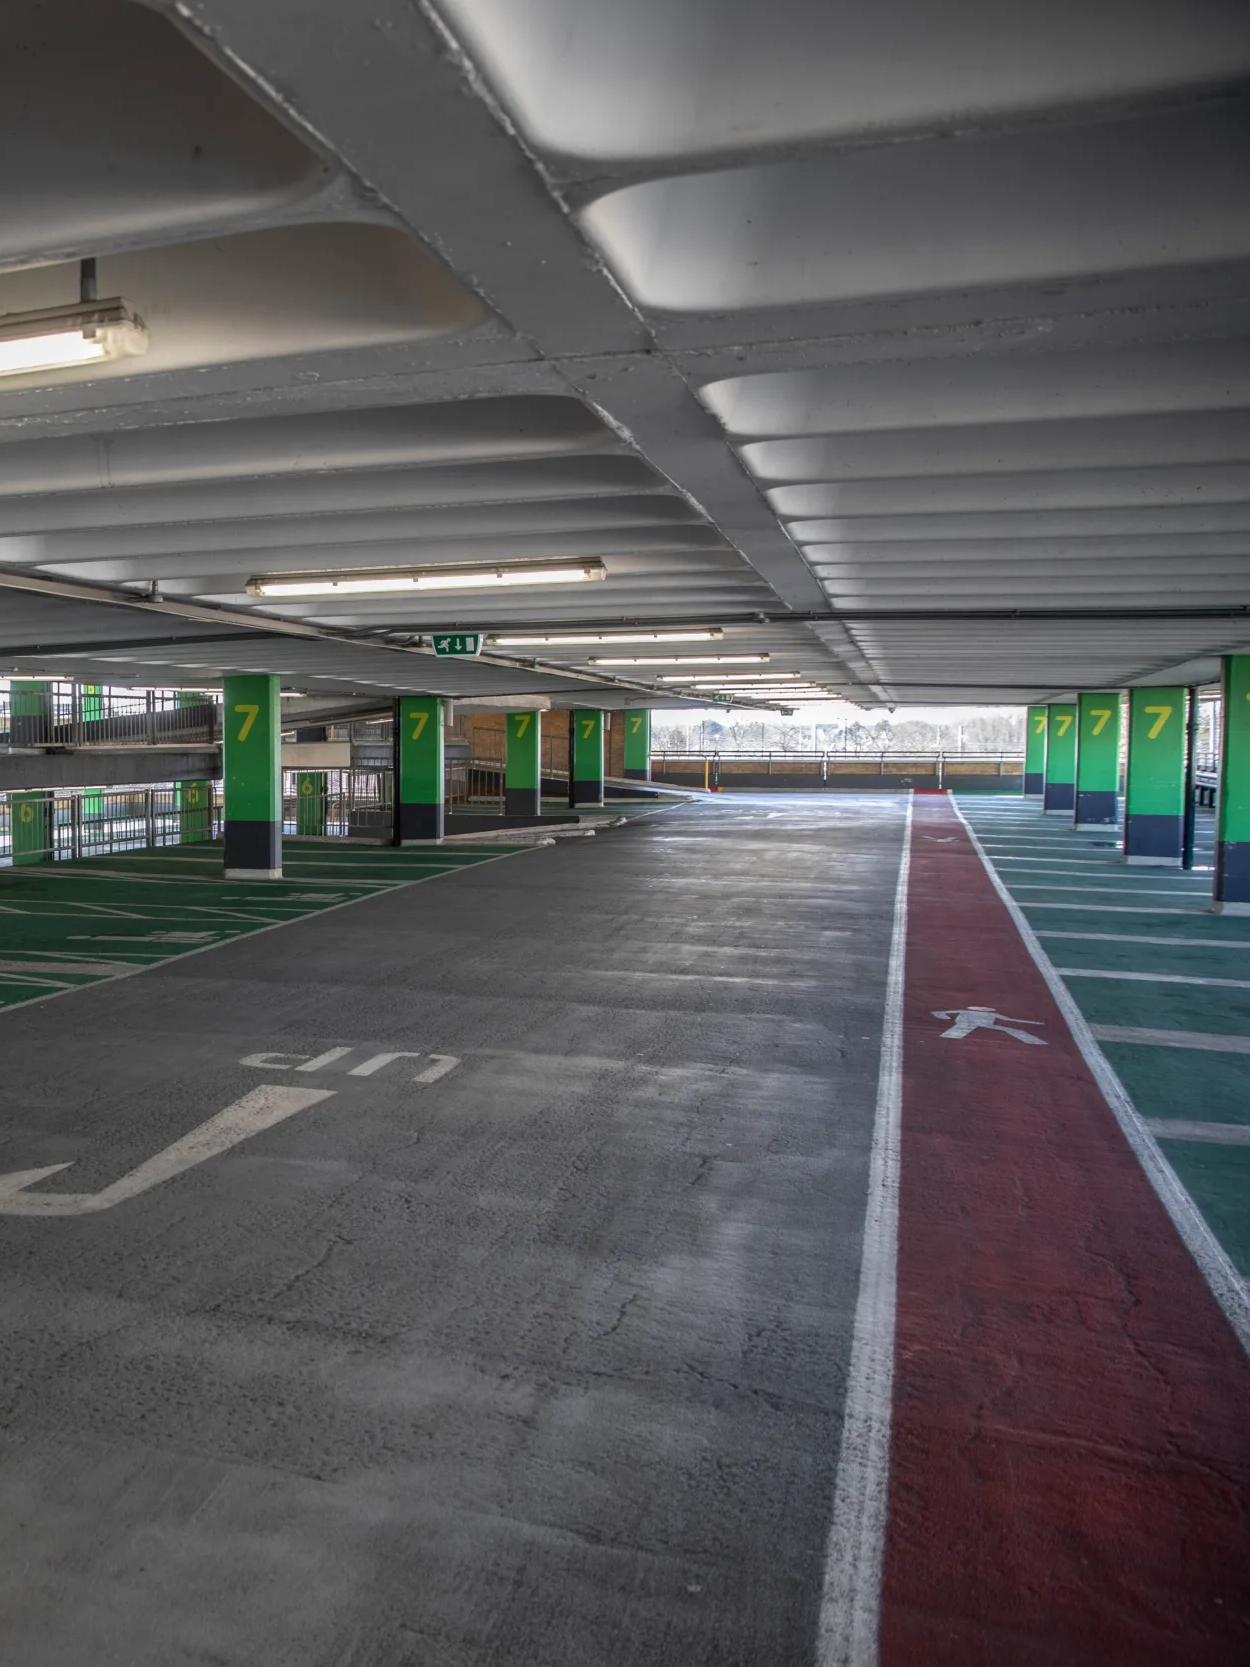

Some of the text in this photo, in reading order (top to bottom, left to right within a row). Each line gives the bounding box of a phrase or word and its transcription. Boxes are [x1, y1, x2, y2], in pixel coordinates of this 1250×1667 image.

[234, 704, 260, 742] 7
[409, 712, 429, 740] 7
[514, 715, 530, 738] 7
[581, 720, 595, 739] 7
[630, 717, 643, 734] 7
[1034, 716, 1046, 734] 7
[1055, 715, 1072, 736] 7
[1090, 709, 1112, 736] 7
[1144, 706, 1172, 739] 7
[19, 802, 34, 823] 6
